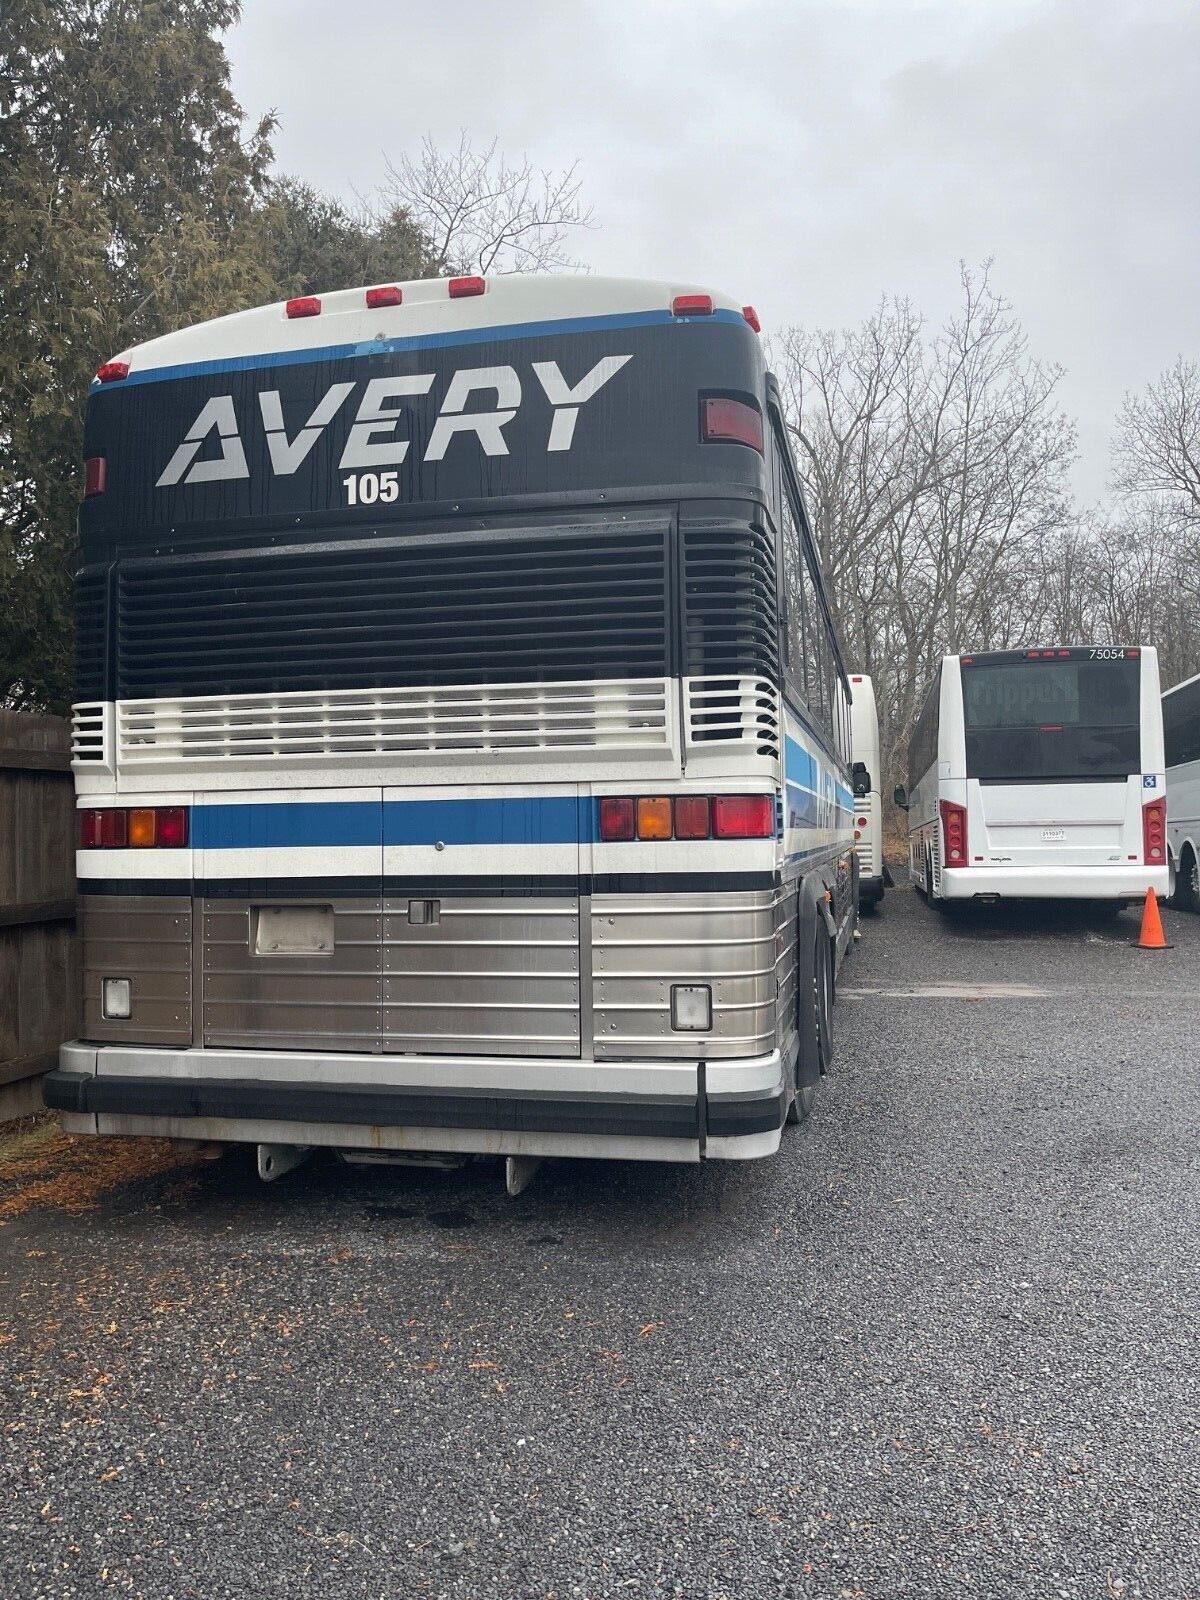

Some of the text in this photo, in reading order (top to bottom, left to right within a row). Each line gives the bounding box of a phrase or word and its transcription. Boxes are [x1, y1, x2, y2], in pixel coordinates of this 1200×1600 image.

[155, 354, 634, 487] AVERY
[343, 471, 399, 505] 105
[1089, 649, 1125, 660] 75054
